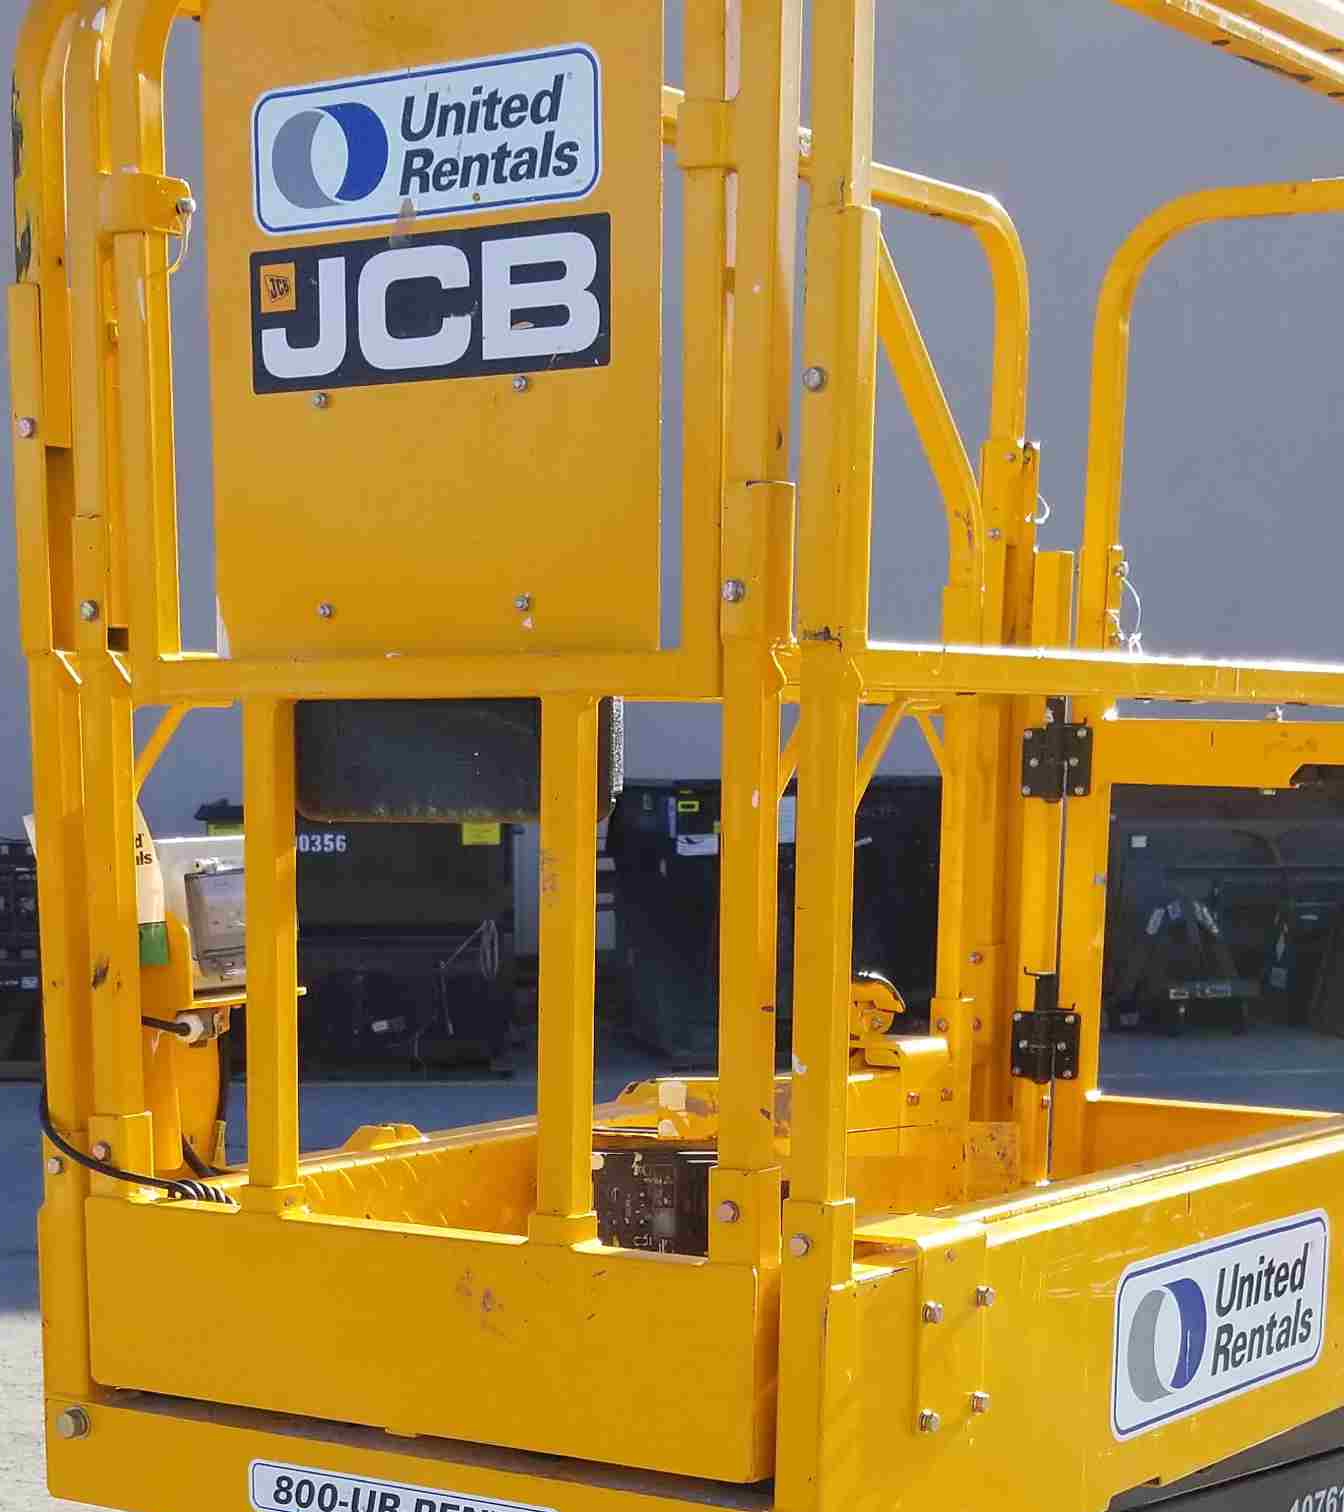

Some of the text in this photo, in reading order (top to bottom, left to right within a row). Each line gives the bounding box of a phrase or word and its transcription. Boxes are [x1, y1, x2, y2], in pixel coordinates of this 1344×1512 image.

[400, 74, 564, 142] United
[399, 131, 580, 196] Rentals
[261, 231, 601, 379] JCB
[296, 833, 347, 852] 0356
[1214, 1242, 1308, 1317] United
[1210, 1298, 1313, 1376] Rentals
